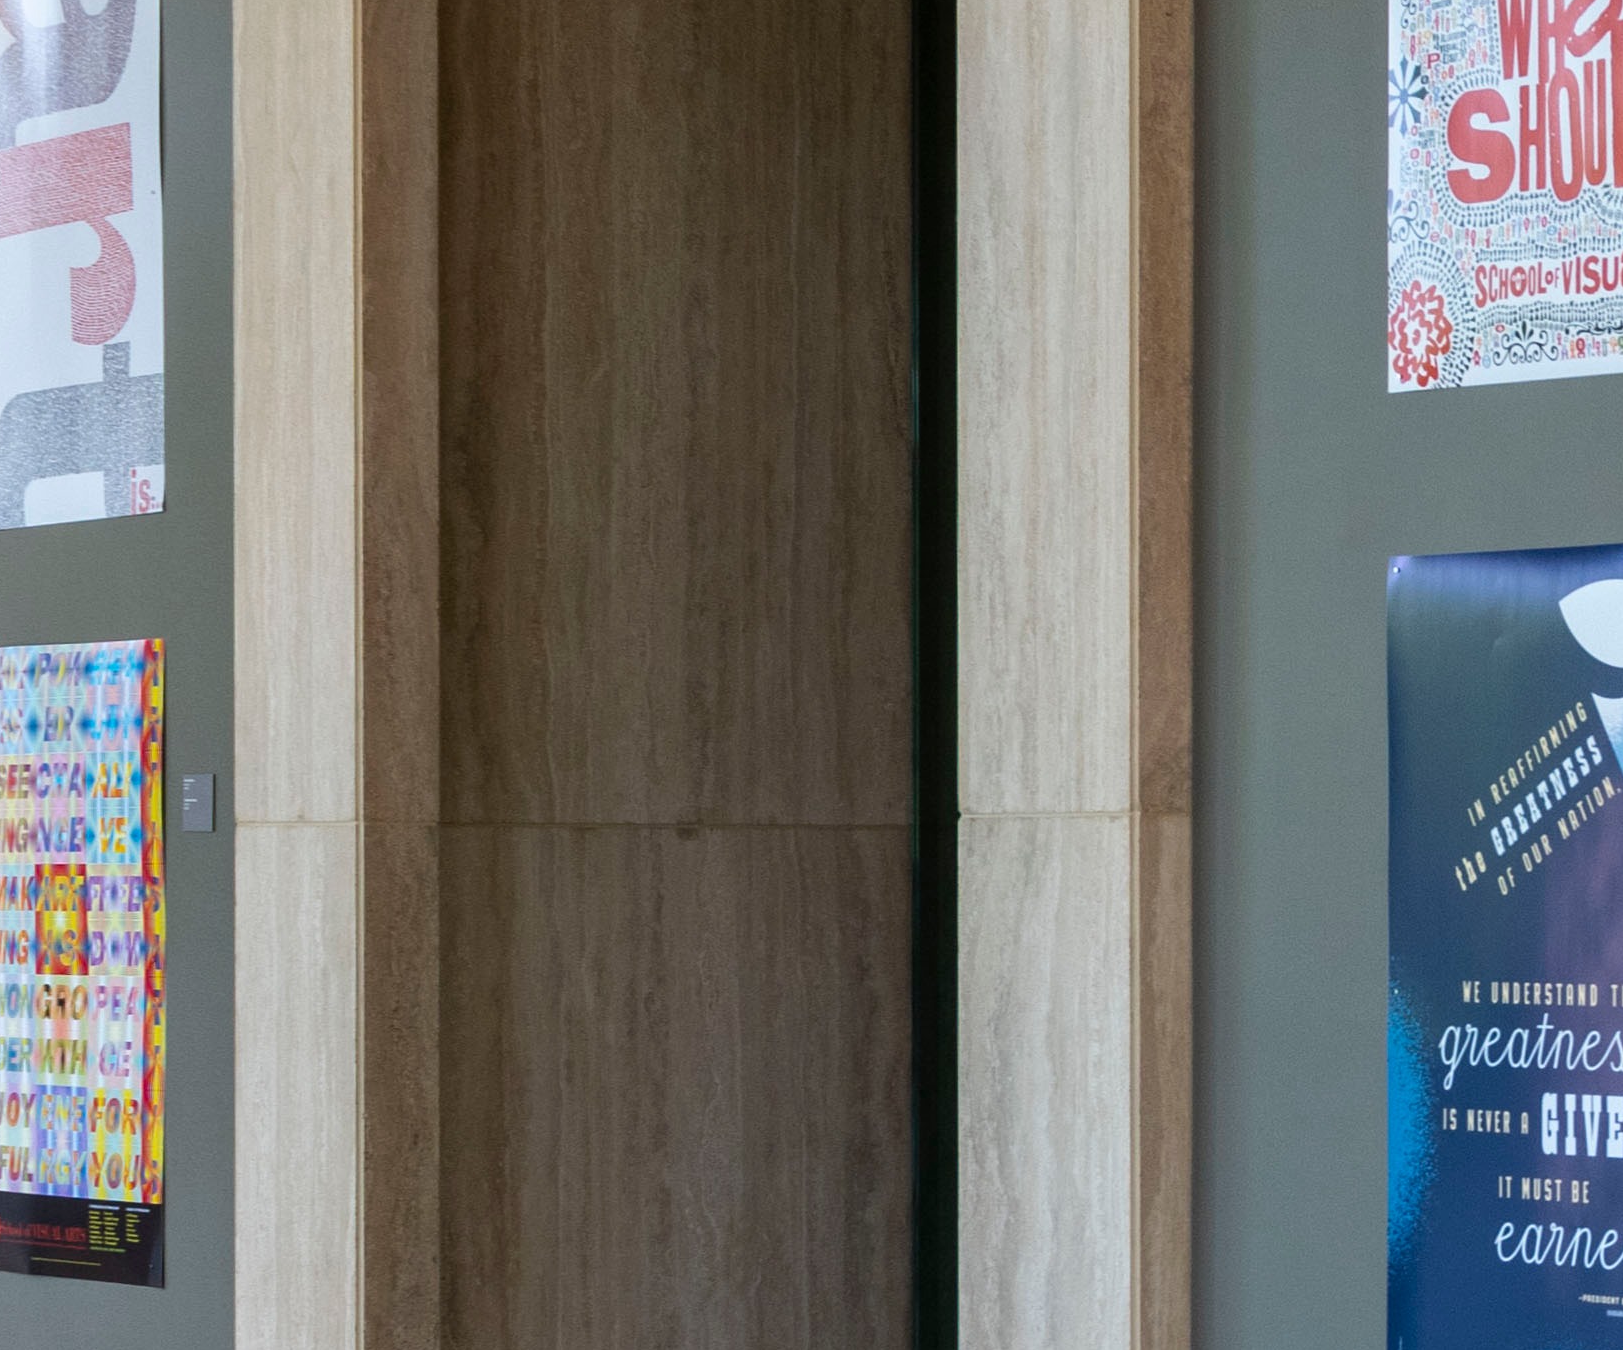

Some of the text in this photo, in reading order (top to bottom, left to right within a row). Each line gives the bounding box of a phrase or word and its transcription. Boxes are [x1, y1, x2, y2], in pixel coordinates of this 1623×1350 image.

[1476, 262, 1546, 308] SCHOOL
[1467, 701, 1588, 828] IN REAFFIRMING
[1454, 734, 1603, 893] the GREATNESS
[1497, 868, 1518, 896] OF
[1522, 835, 1553, 873] OUR
[1462, 981, 1481, 1003] WE
[1491, 981, 1599, 1007] UNDERSTAND
[1443, 1107, 1458, 1131] IS
[1466, 1108, 1511, 1133] NEVER
[1521, 1111, 1529, 1135] A
[1498, 1176, 1590, 1204] IT MUST BE
